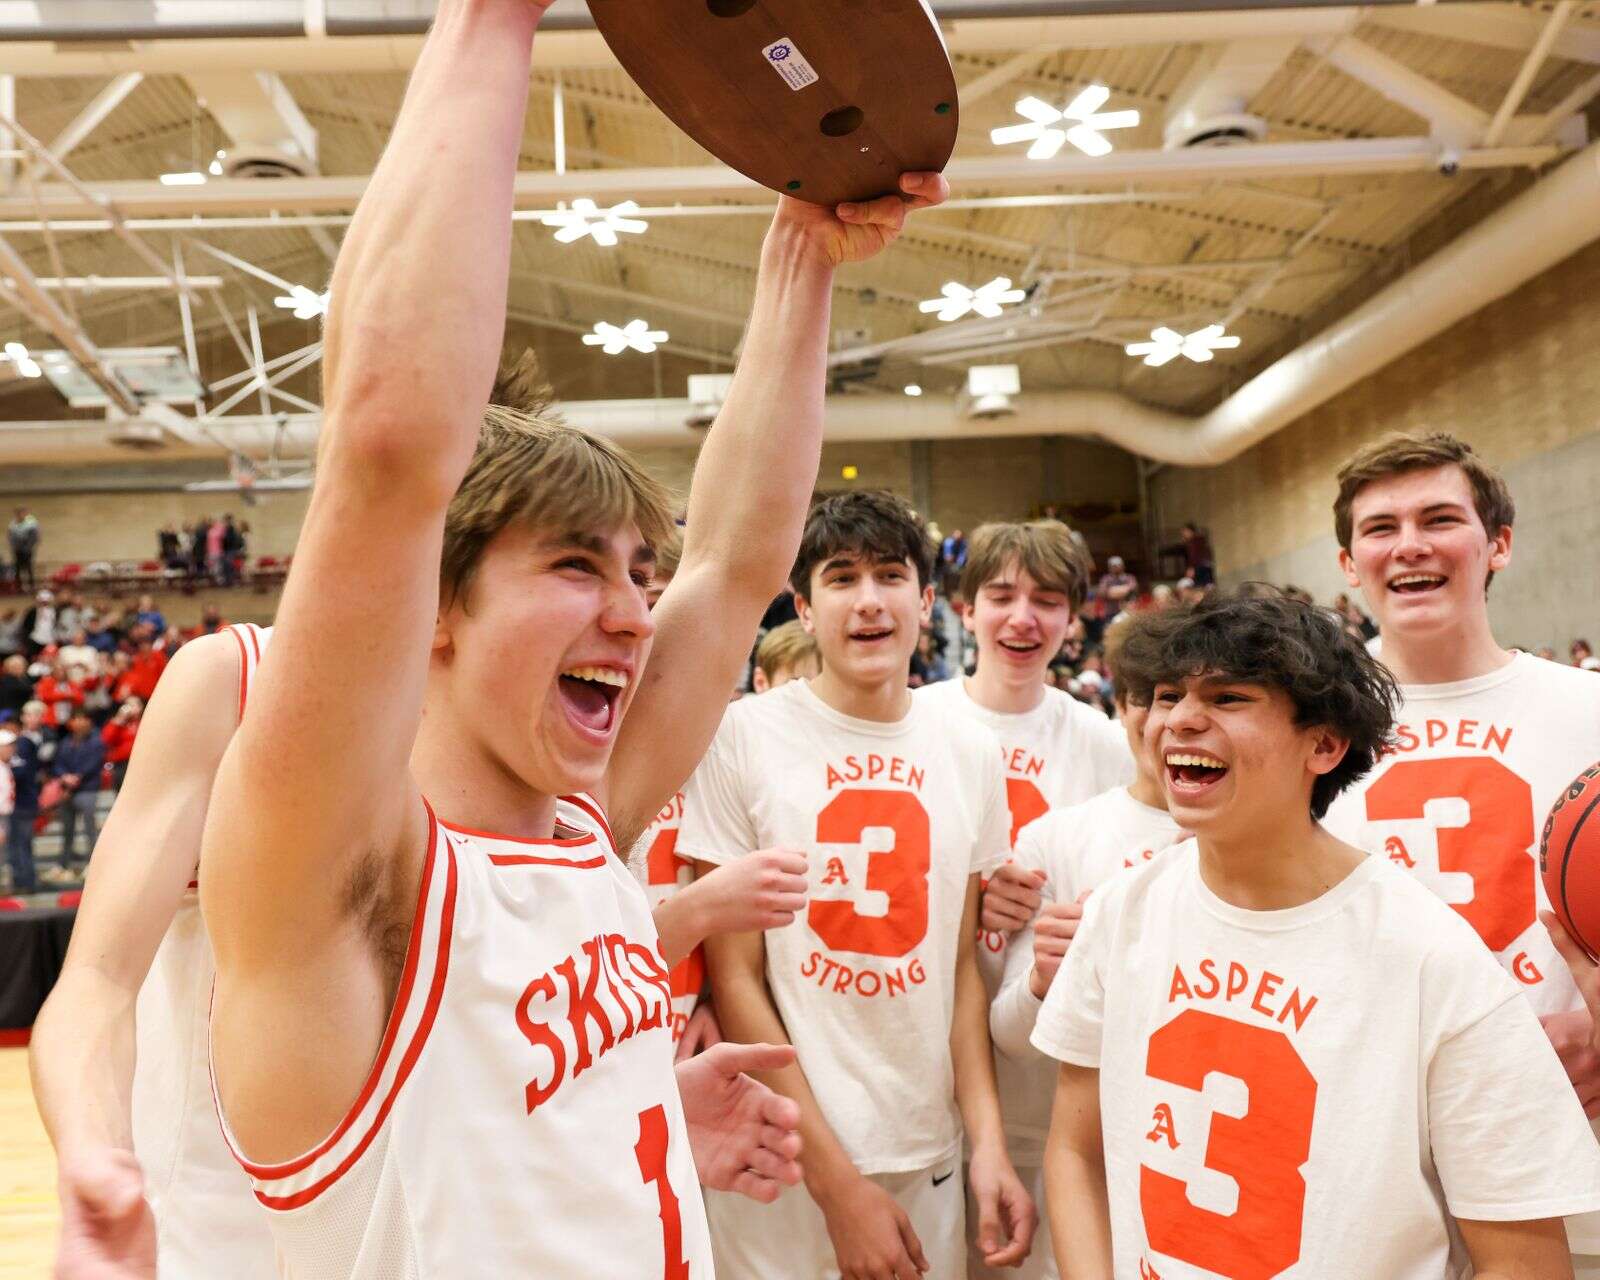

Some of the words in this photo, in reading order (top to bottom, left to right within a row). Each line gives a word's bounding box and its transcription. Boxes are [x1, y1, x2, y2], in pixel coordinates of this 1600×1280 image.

[825, 755, 926, 792] ASPEN
[806, 788, 931, 958] 3
[821, 856, 850, 886] A
[1364, 755, 1537, 953] 3
[800, 944, 927, 998] STRONG
[1167, 957, 1320, 1034] ASPEN
[514, 931, 673, 1116] SKIER
[1138, 1008, 1319, 1280] 3
[1144, 1101, 1182, 1151] A
